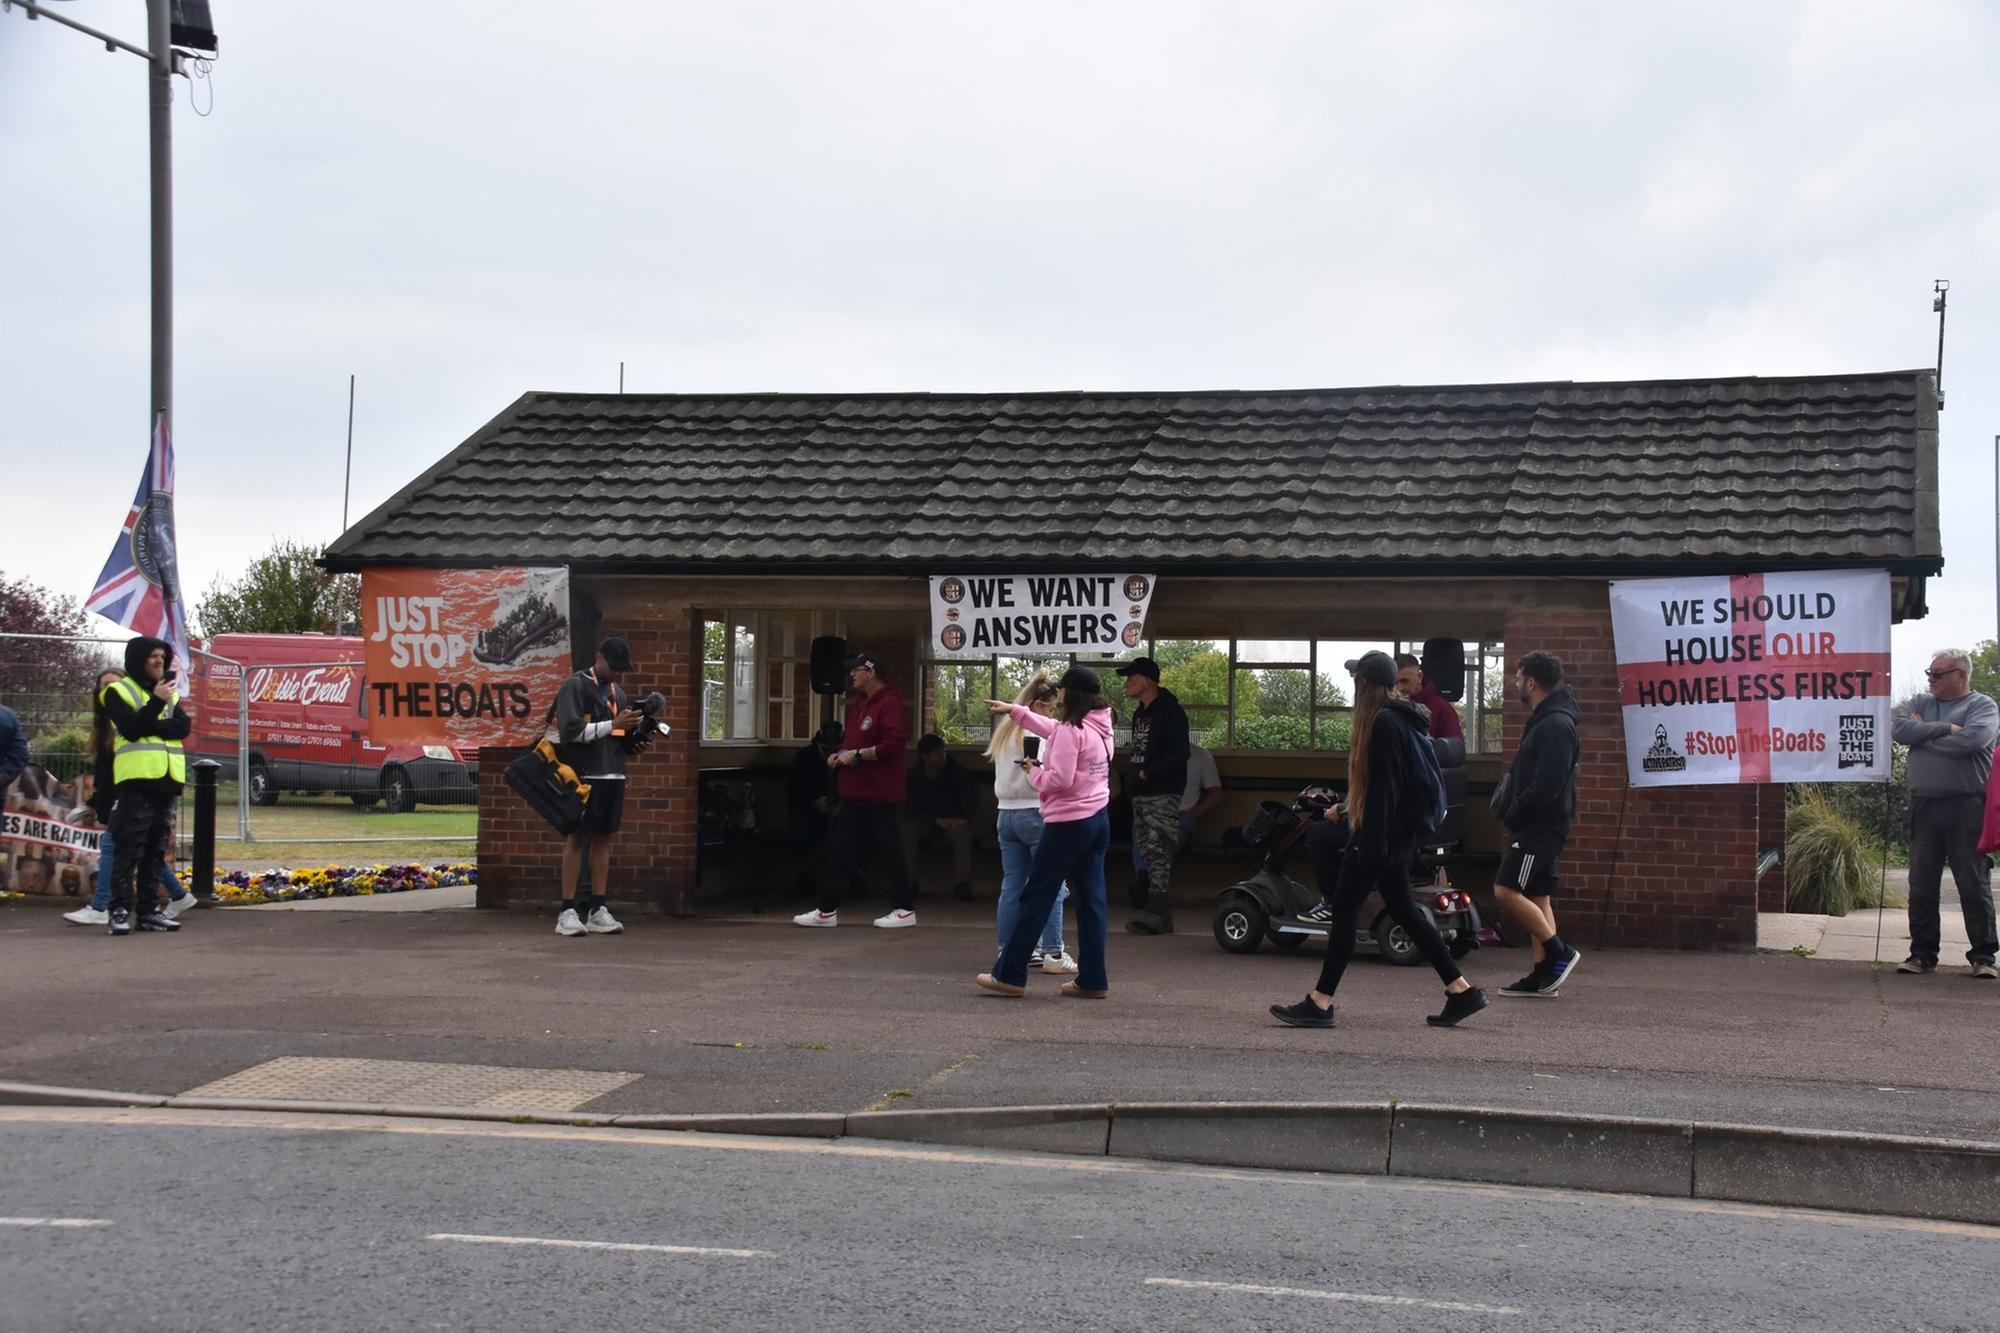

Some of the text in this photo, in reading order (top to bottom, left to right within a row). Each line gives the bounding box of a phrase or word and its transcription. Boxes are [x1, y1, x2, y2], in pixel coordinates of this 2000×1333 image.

[968, 577, 1115, 608] WE WANT
[1661, 592, 1835, 626] WE SHOULD
[371, 596, 443, 641] JUST
[972, 613, 1117, 648] ANSWERS
[390, 632, 466, 669] STOP
[1665, 632, 1836, 666] HOUSE OUR
[300, 668, 350, 705] Events
[372, 682, 531, 717] THE BOATS
[1638, 671, 1872, 708] HOMELESS FIRST
[1840, 730, 1874, 741] STOP
[1841, 718, 1872, 728] JUST
[1685, 727, 1825, 760] #StopTheBoats
[1839, 742, 1873, 752] THE
[1840, 752, 1872, 761] BOATS
[2, 815, 103, 850] ES ARE RAPIN
